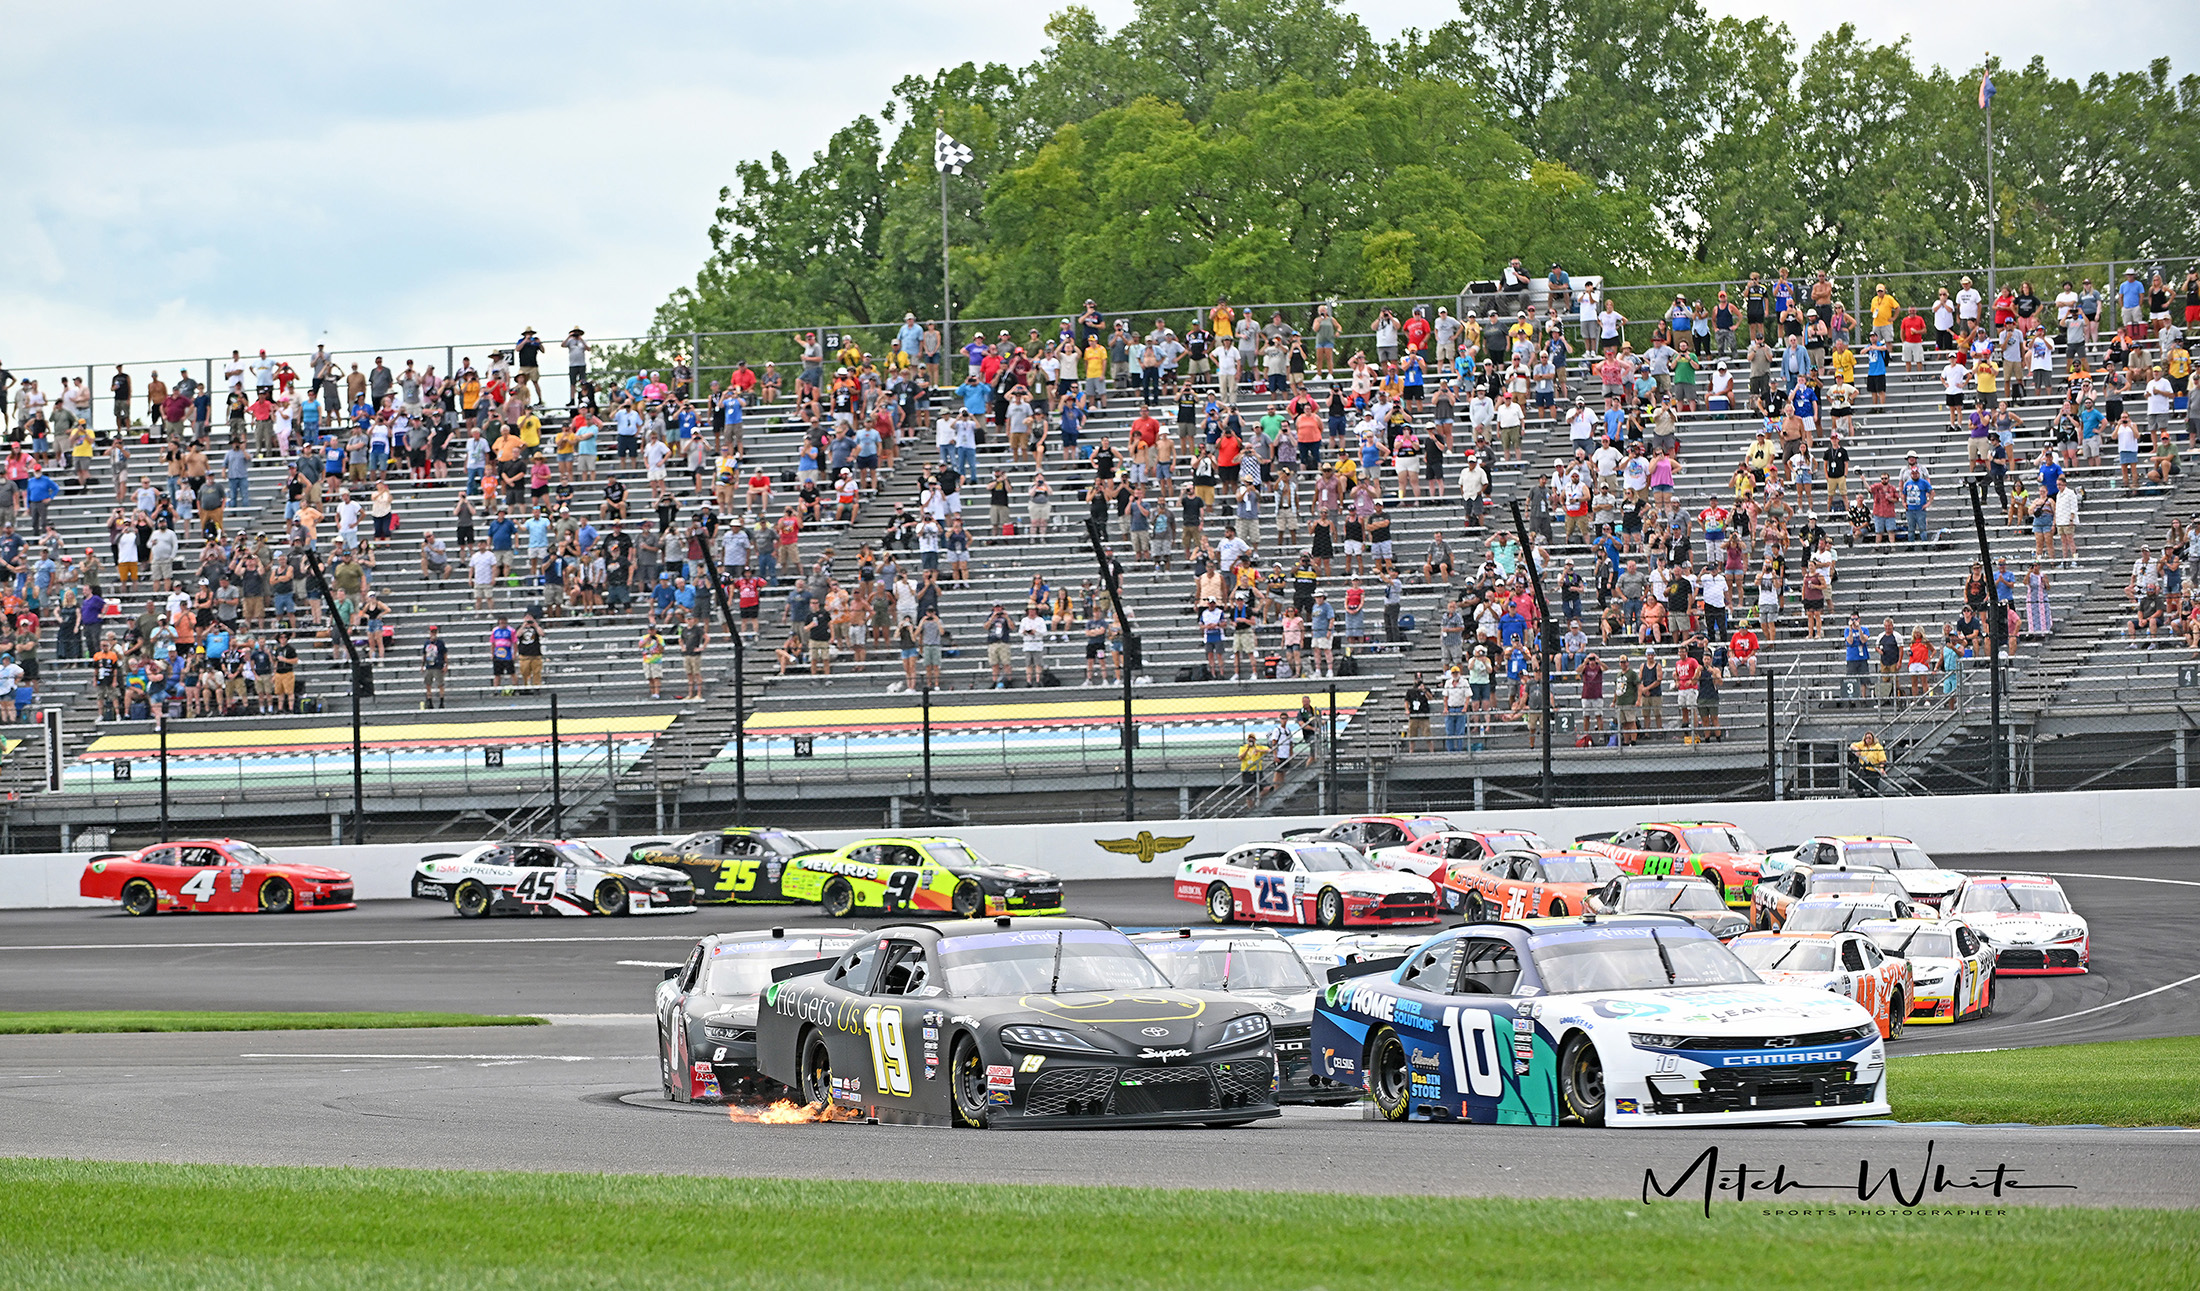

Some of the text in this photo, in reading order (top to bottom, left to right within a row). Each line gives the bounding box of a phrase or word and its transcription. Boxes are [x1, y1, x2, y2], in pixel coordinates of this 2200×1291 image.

[1801, 289, 1808, 300] 2
[826, 337, 839, 347] 23
[503, 352, 513, 363] 22
[2184, 670, 2192, 682] 4
[1846, 683, 1854, 694] 3
[1561, 717, 1568, 728] 2
[797, 742, 810, 754] 24
[488, 752, 501, 764] 23
[116, 766, 129, 778] 22
[461, 866, 514, 877] SPRINGS
[802, 859, 879, 880] MENARDS
[1643, 855, 1674, 875] 88
[714, 859, 761, 892] 35
[180, 869, 223, 903] 4
[514, 870, 558, 901] 45
[885, 870, 921, 907] 9
[1254, 873, 1290, 912] 25
[1503, 887, 1527, 920] 36
[1008, 930, 1060, 945] xfinity
[1593, 927, 1655, 941] xfinity
[726, 942, 779, 953] xfinity
[1967, 960, 1978, 1007] 7
[777, 983, 862, 1036] He Gets Us.
[1351, 986, 1398, 1023] HOME
[1396, 998, 1423, 1016] WATER
[1393, 1010, 1436, 1033] SOLUTIONS
[1559, 1015, 1594, 1031] GOODYEAR
[713, 1047, 728, 1062] 8
[863, 1003, 913, 1098] 19
[1137, 1047, 1192, 1064] Supra
[1442, 1006, 1503, 1098] 10
[1019, 1054, 1047, 1073] 19
[1333, 1057, 1355, 1070] CELSIUS
[1655, 1053, 1680, 1074] 10
[1723, 1051, 1842, 1067] CAMARO
[988, 1066, 1012, 1076] SIMPSON
[989, 1076, 1013, 1085] ARP
[1411, 1083, 1441, 1100] STORE
